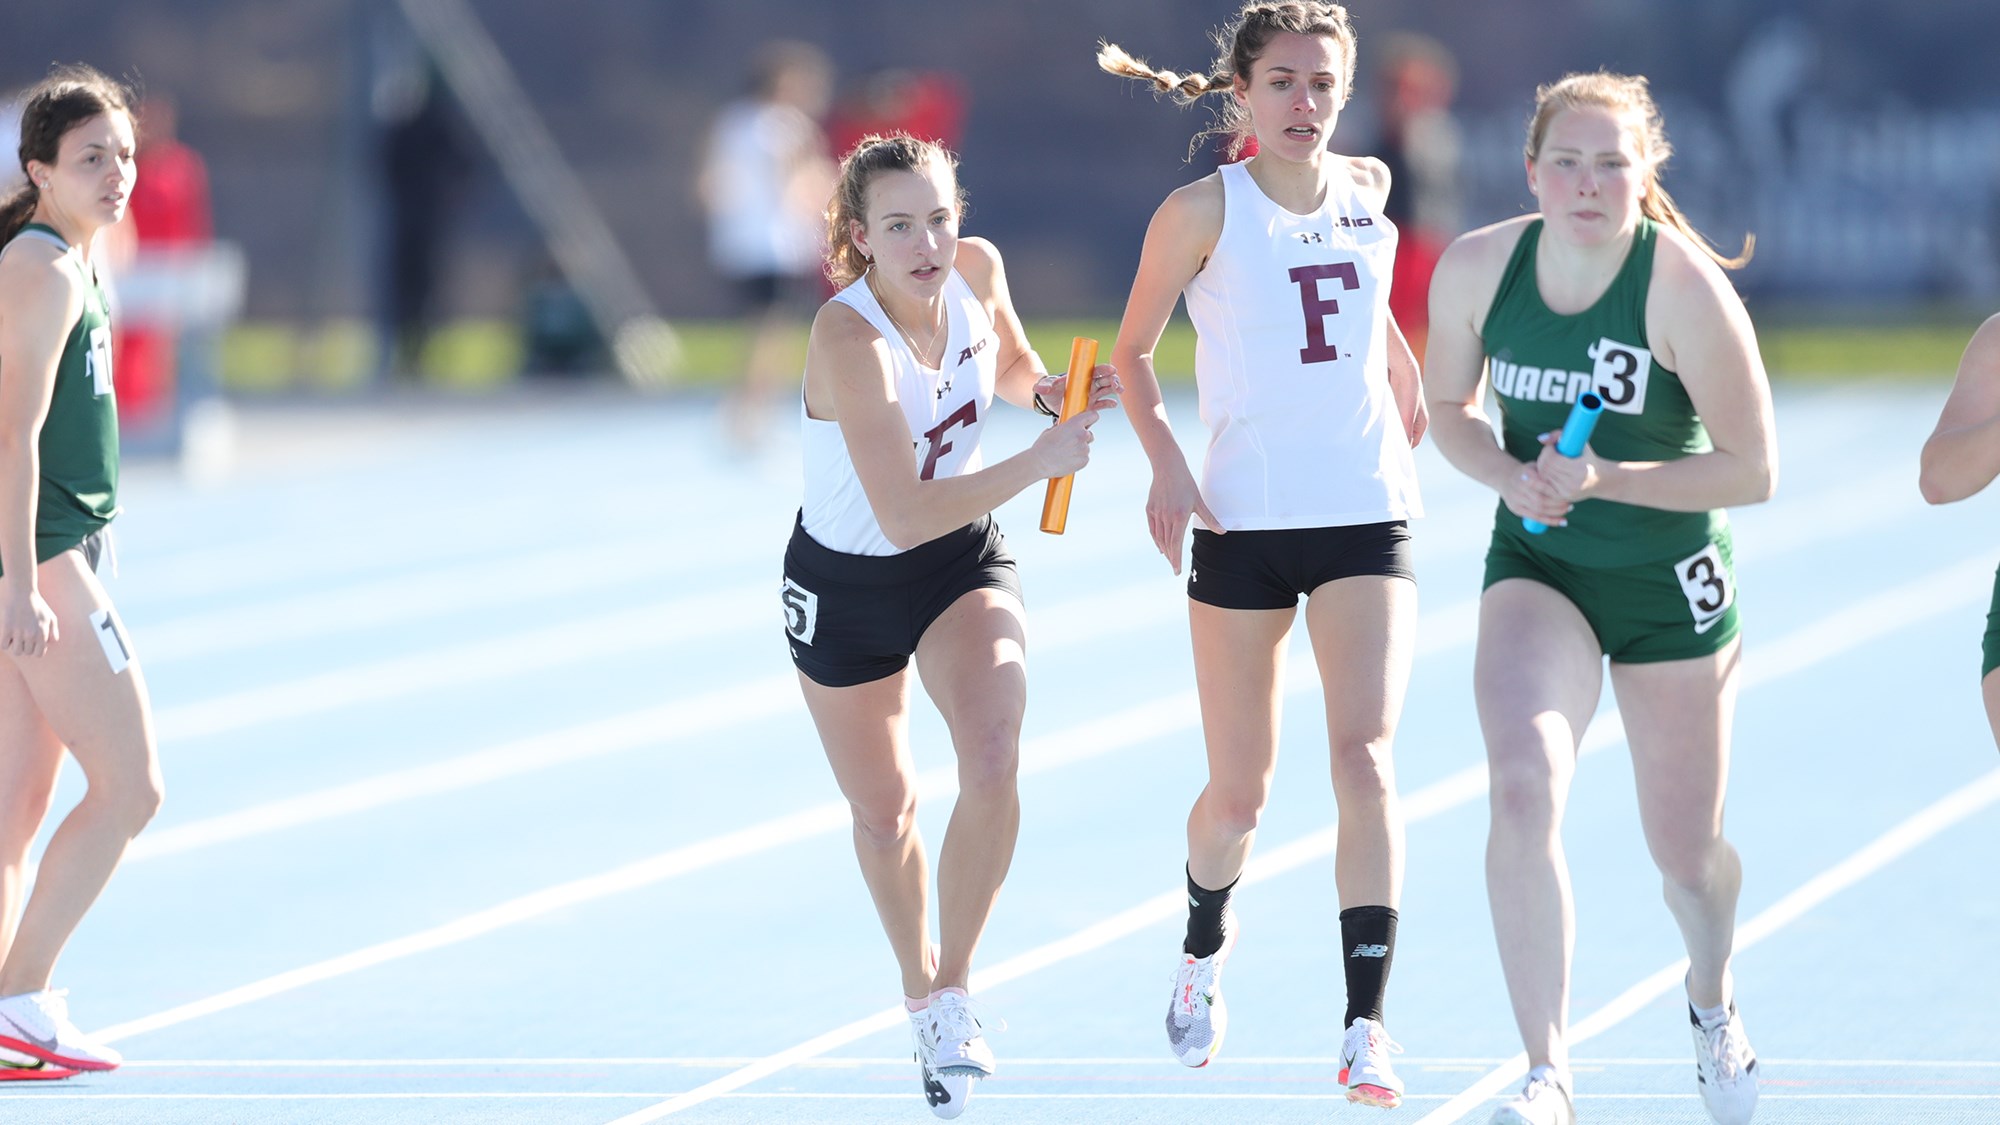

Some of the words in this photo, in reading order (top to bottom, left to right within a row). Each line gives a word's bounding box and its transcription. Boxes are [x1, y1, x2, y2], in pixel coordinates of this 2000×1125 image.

[1288, 261, 1360, 364] F
[957, 338, 987, 366] A10
[1599, 349, 1638, 405] 3
[921, 399, 977, 481] F
[782, 585, 807, 636] 5
[1687, 556, 1725, 612] 3
[101, 611, 130, 661] 1
